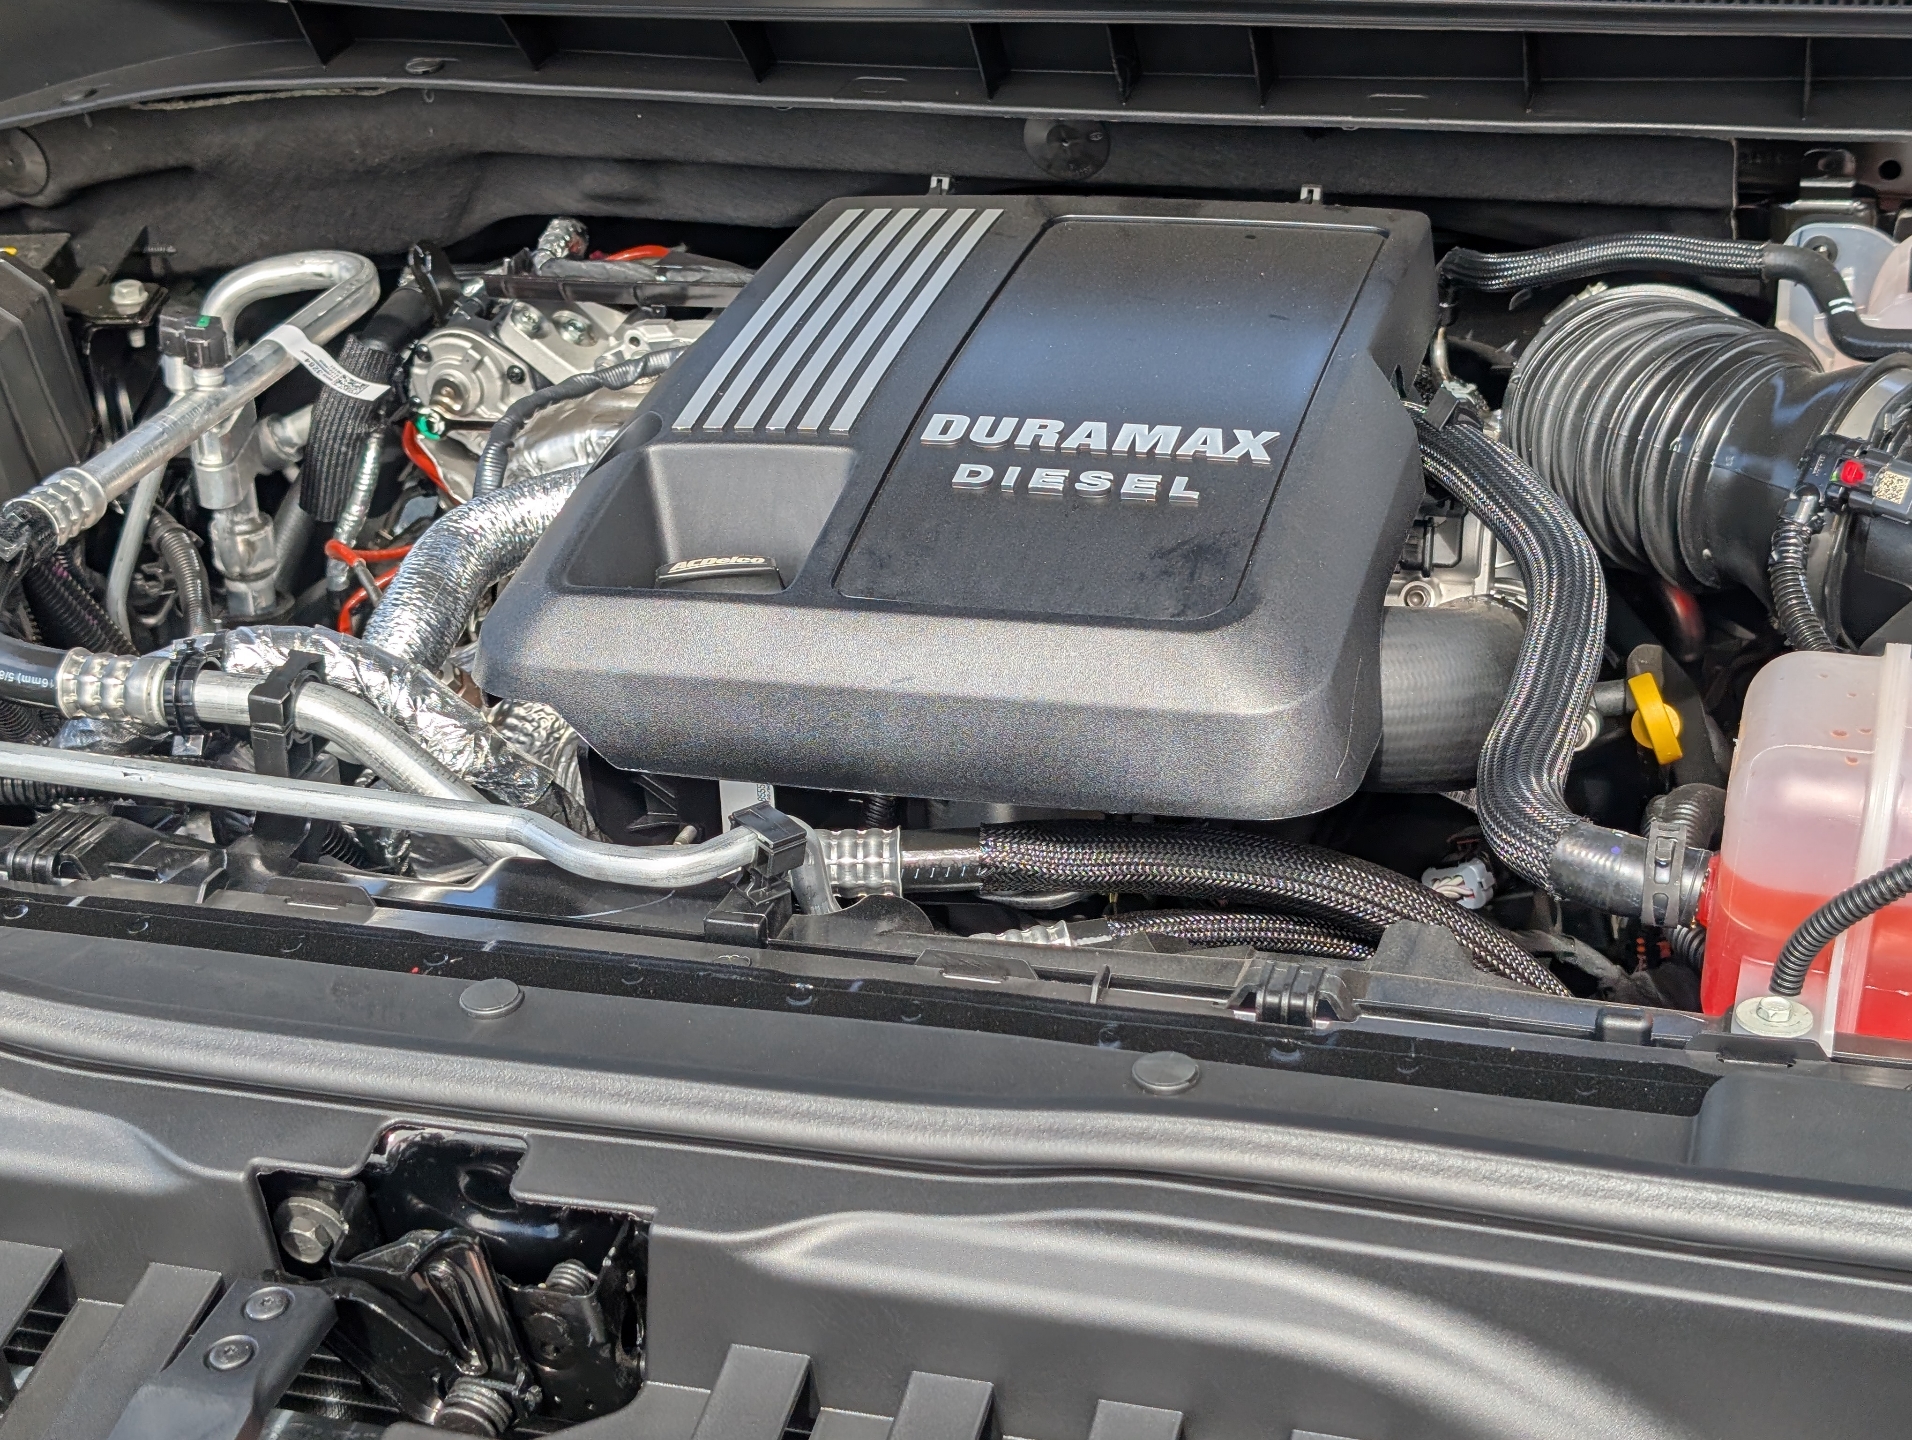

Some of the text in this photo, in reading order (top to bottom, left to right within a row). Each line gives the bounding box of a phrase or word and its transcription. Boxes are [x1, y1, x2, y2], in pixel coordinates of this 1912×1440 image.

[920, 413, 1280, 464] DURAMAX
[951, 463, 1200, 502] DIESEL
[668, 556, 766, 574] ACDelco
[17, 673, 56, 689] 16mm)
